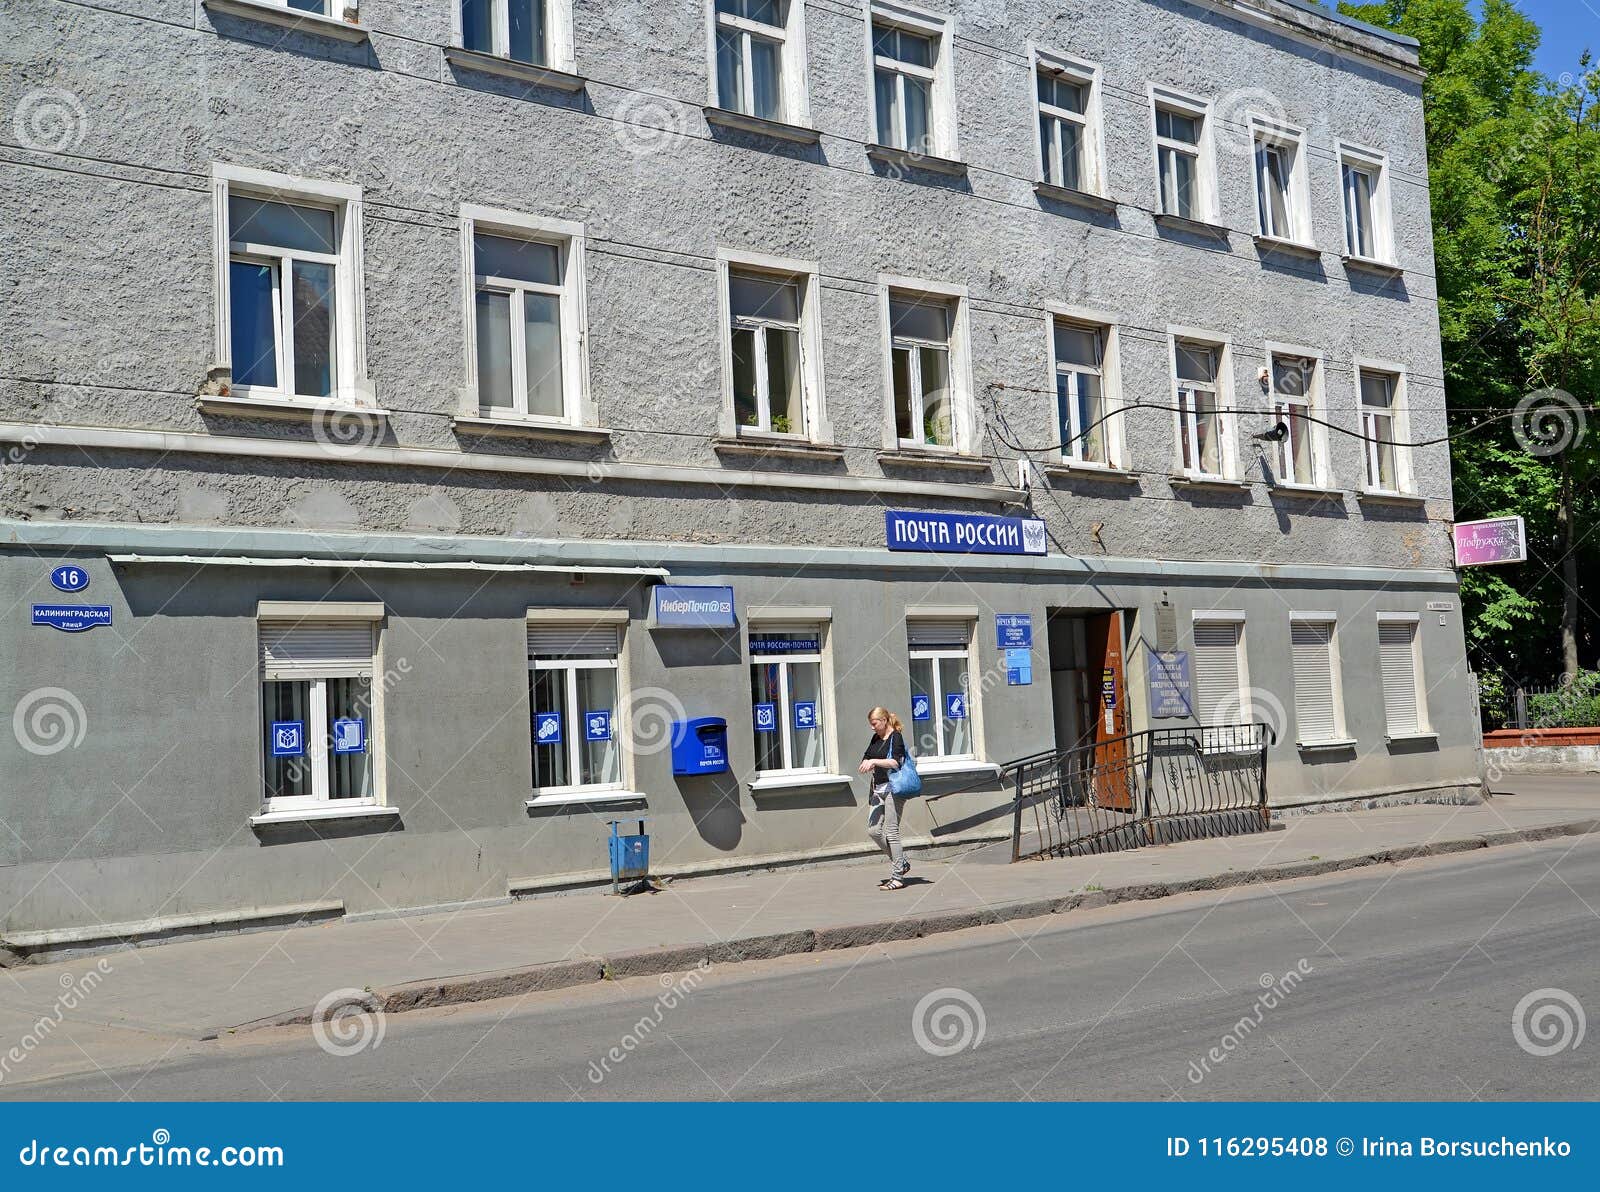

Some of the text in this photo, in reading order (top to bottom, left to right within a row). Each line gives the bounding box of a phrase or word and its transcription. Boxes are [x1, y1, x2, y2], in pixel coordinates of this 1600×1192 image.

[894, 519, 1019, 546] ПОЧТА РОССИИ
[1458, 530, 1505, 550] Подружка
[60, 570, 79, 585] 16
[35, 609, 109, 618] КАЛИНИНГРАДСКАЯ
[749, 641, 766, 649] ОЧТА
